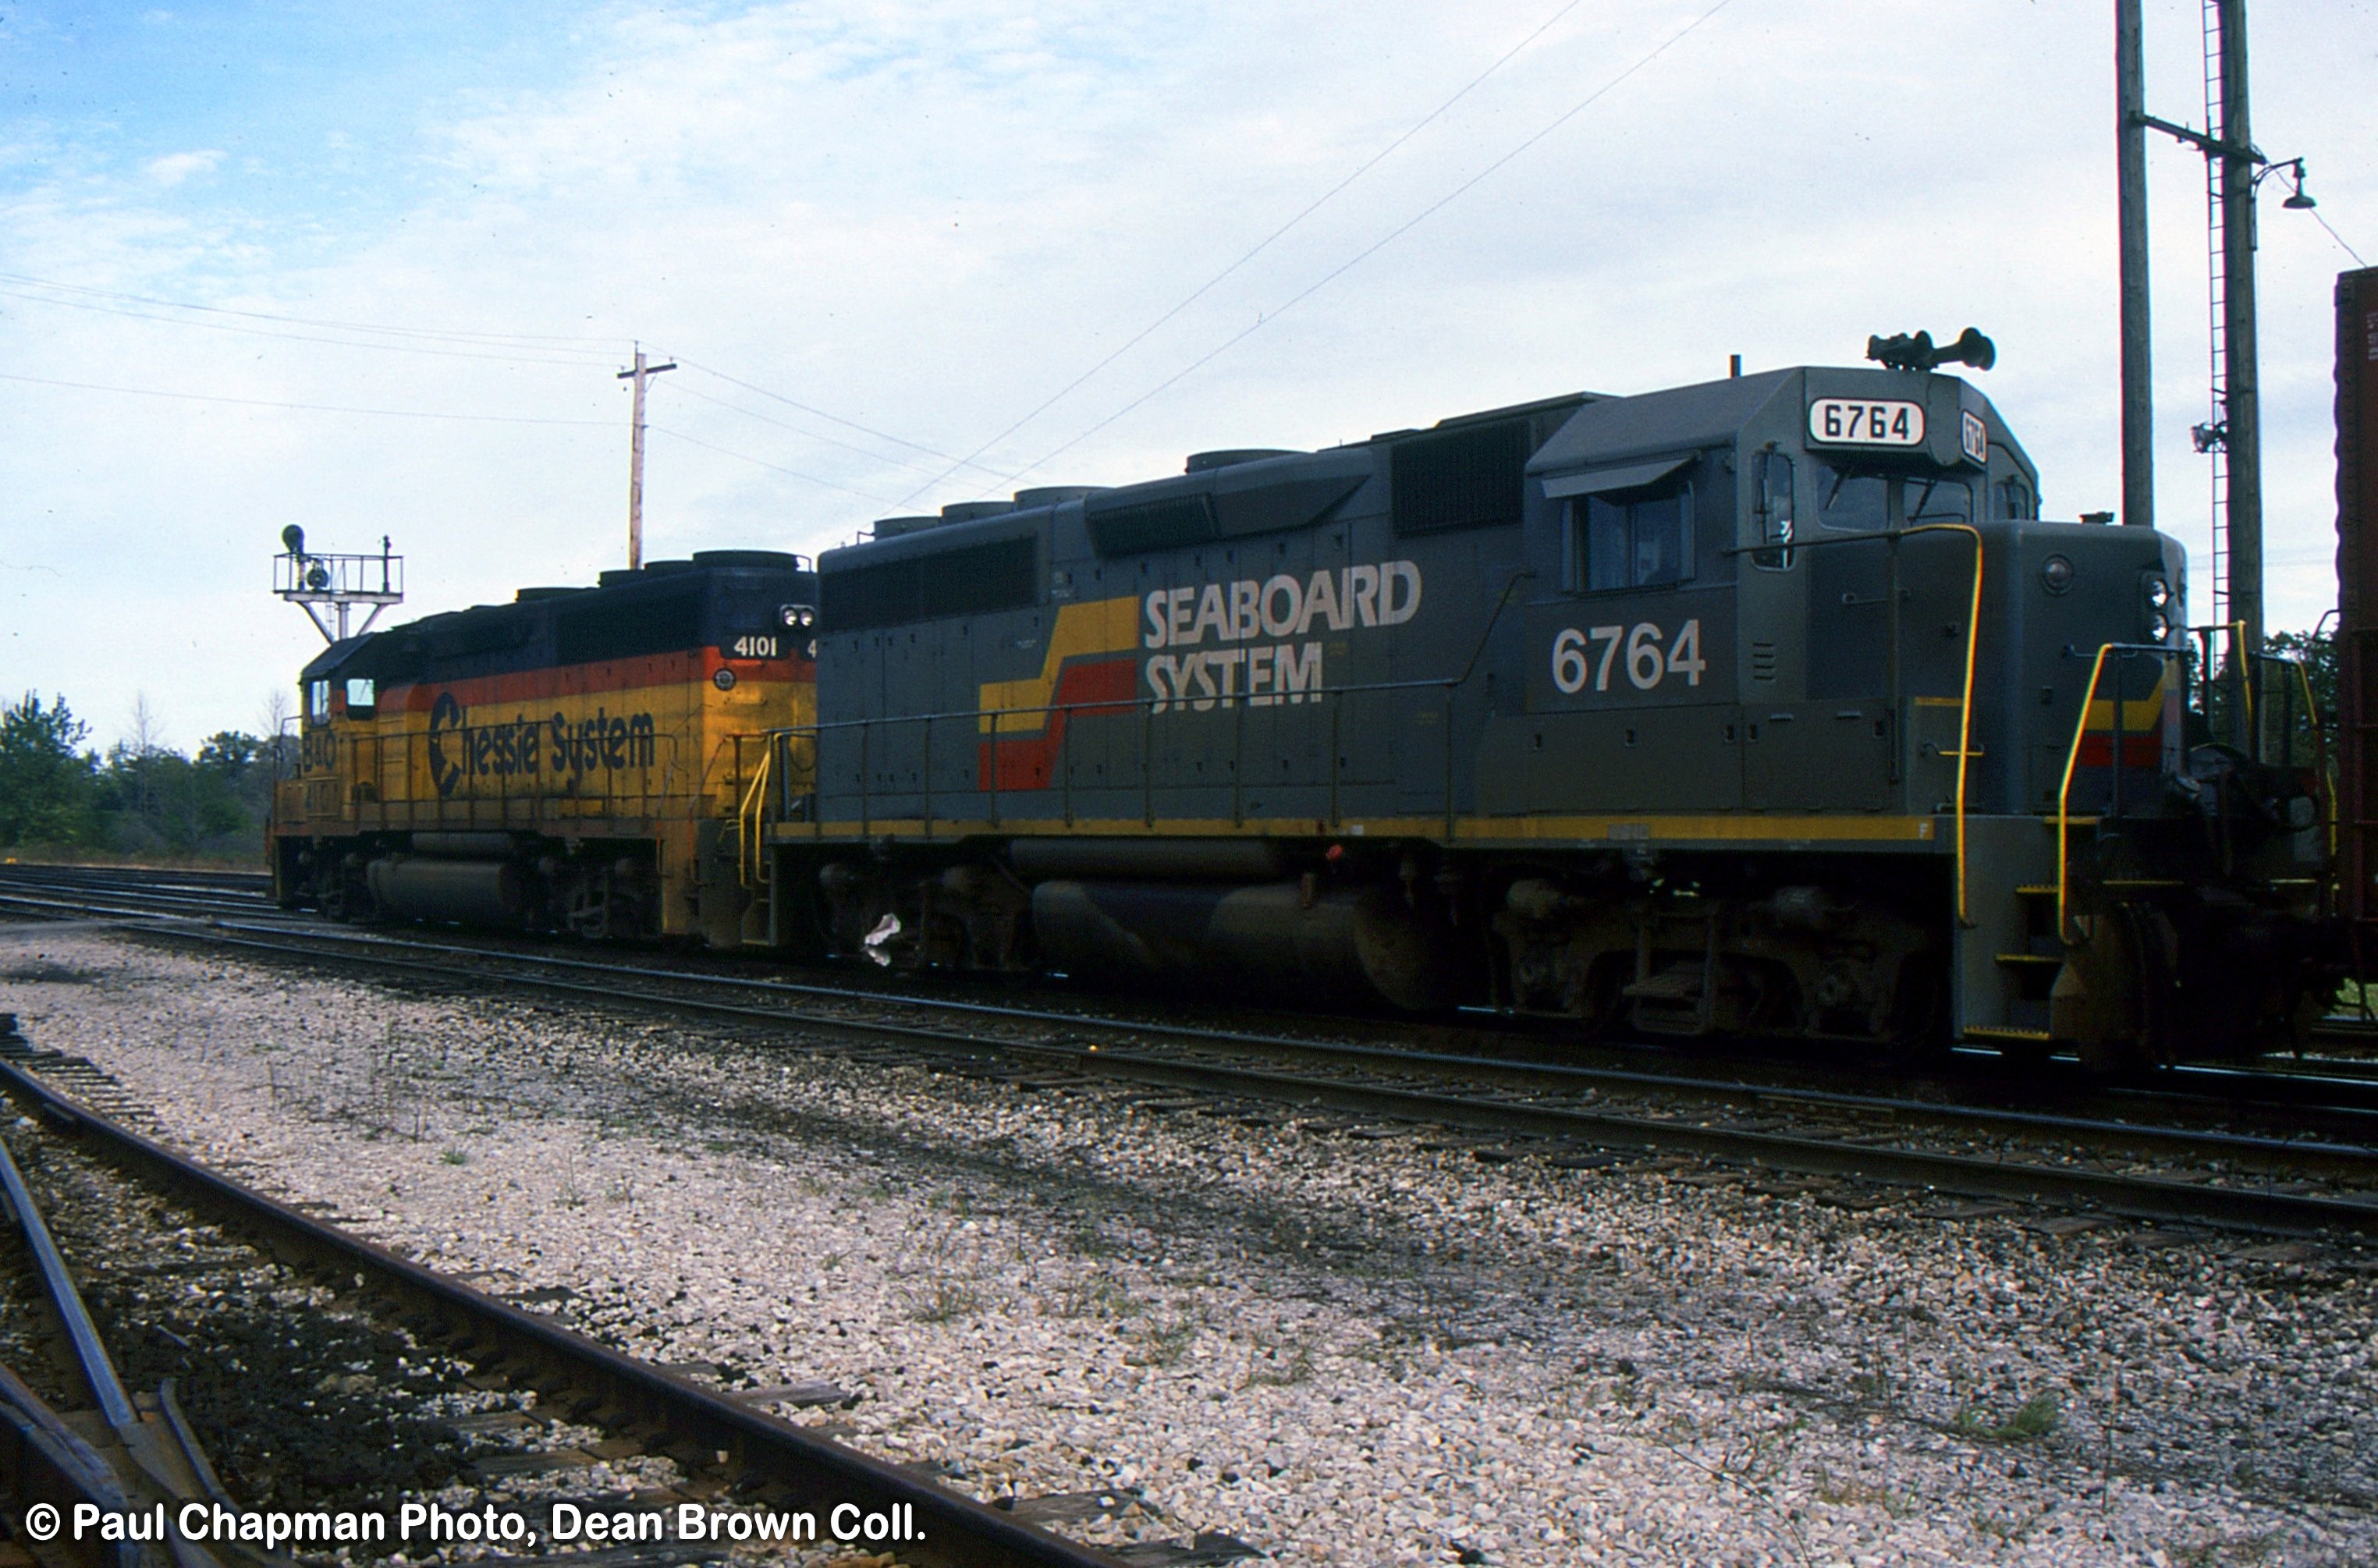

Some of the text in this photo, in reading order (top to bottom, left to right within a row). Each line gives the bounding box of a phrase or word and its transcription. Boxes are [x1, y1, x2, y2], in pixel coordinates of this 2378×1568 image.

[1824, 404, 1909, 440] 6764
[1145, 560, 1421, 649] SEABOARD
[733, 636, 777, 657] 4101
[1145, 641, 1322, 715] SYSTEM
[1552, 619, 1706, 694] 6764
[429, 691, 655, 796] Chessie System
[1919, 823, 1929, 839] F
